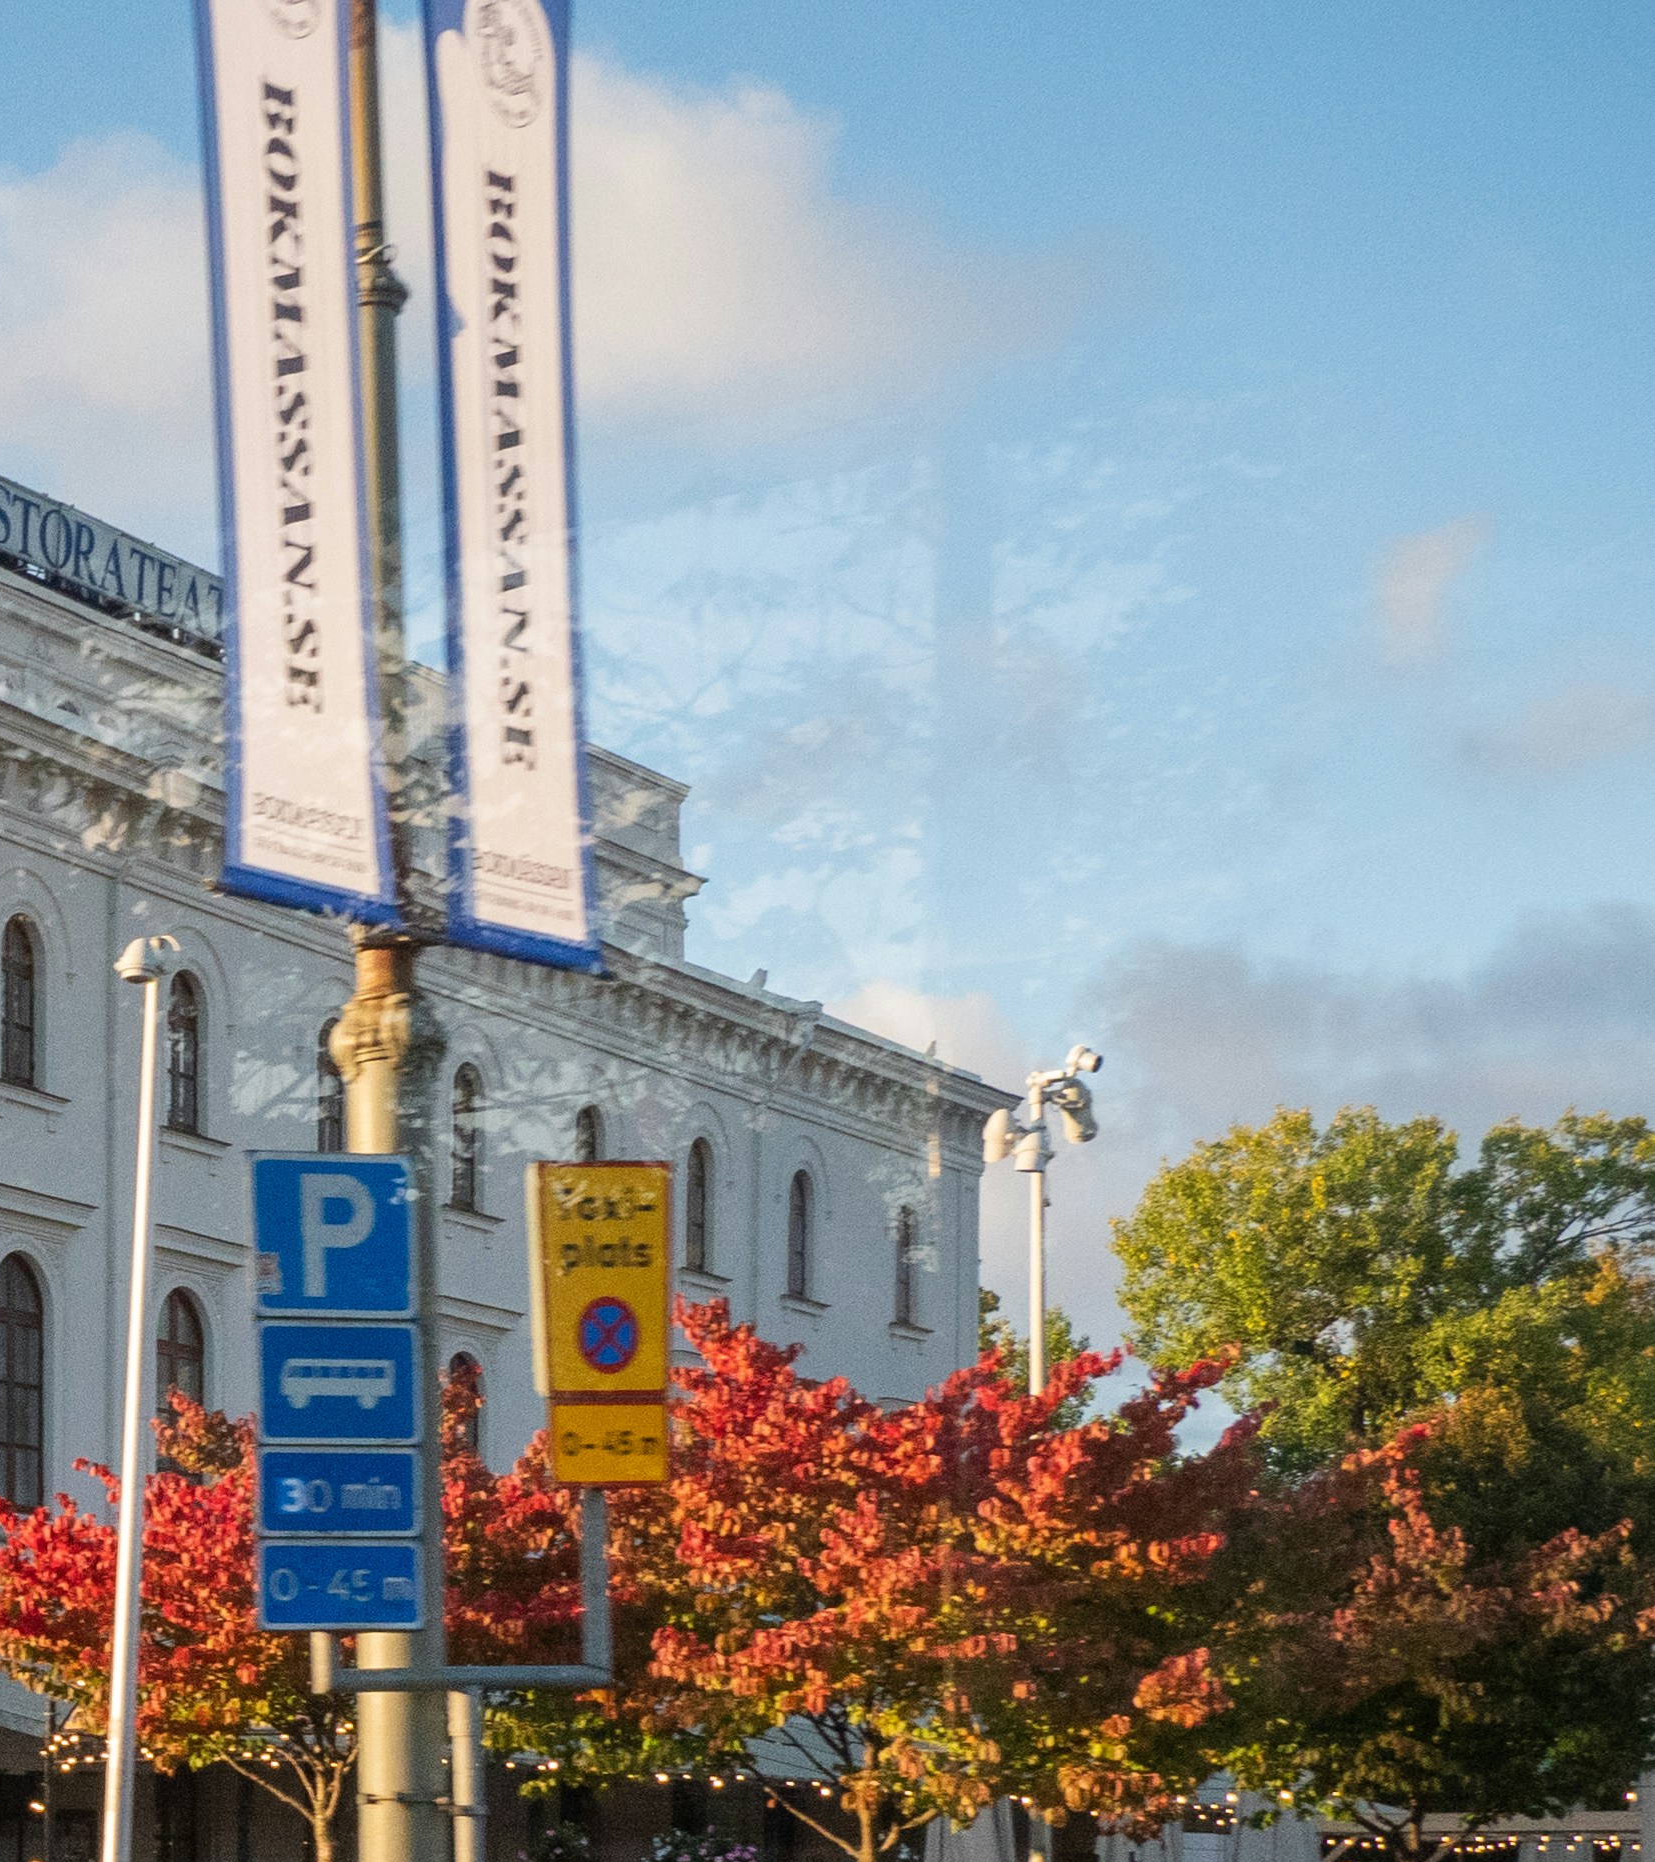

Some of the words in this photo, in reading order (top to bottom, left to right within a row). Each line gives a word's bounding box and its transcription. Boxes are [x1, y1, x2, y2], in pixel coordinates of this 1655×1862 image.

[300, 1173, 374, 1298] P
[562, 1236, 652, 1275] plats
[280, 1478, 333, 1513] 30
